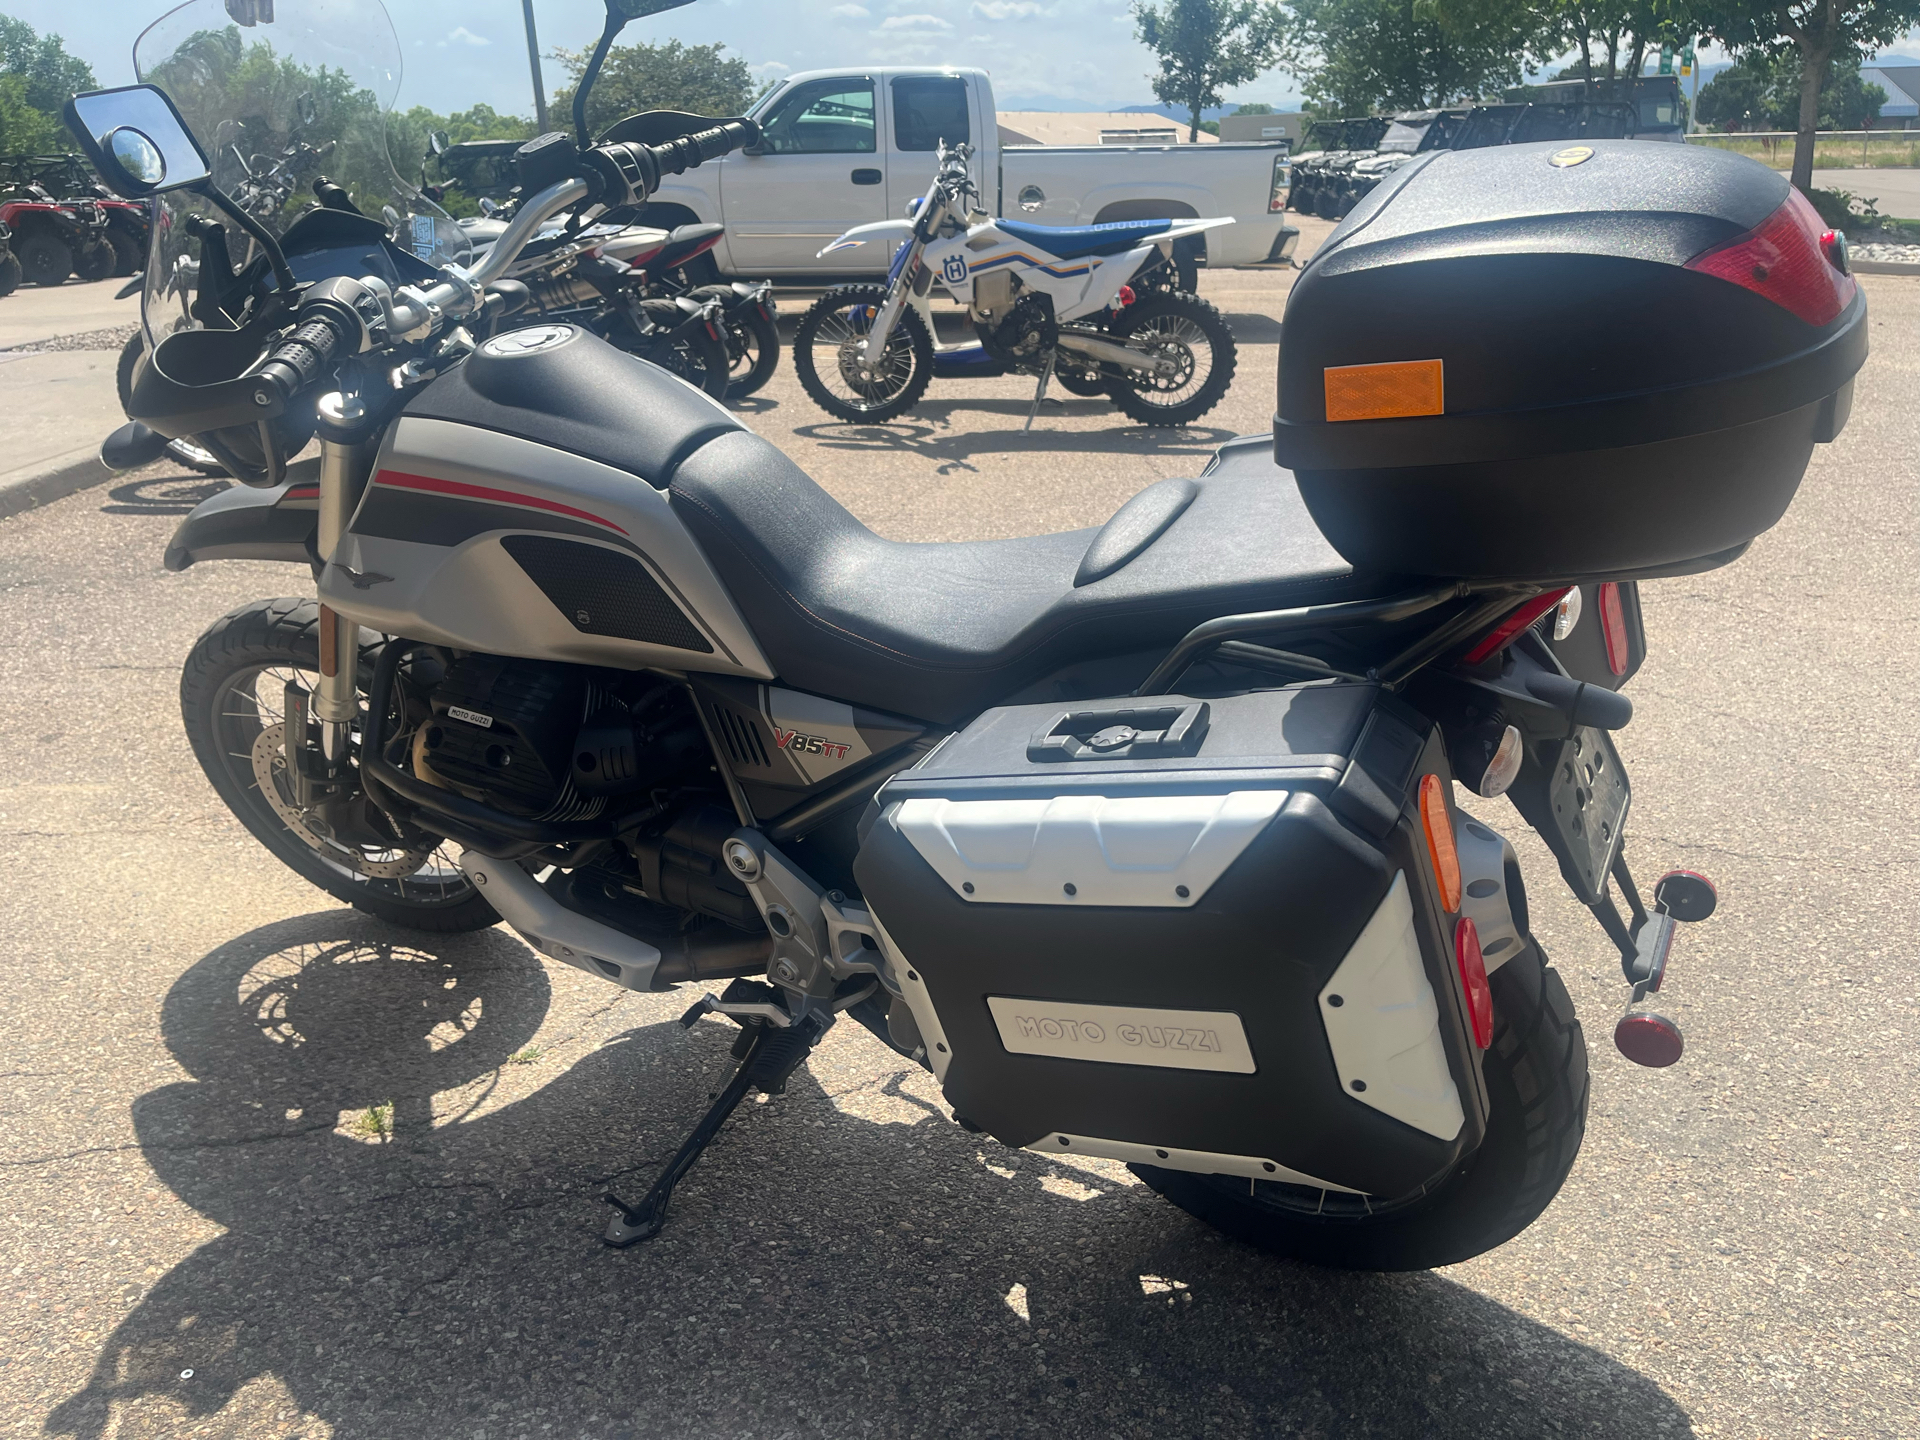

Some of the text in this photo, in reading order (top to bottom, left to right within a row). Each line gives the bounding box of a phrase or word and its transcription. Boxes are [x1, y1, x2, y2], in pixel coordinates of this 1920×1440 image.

[451, 708, 490, 725] MOTO GUZZI
[774, 726, 852, 760] V85TT
[1015, 1015, 1222, 1053] MOTO GUZZI
